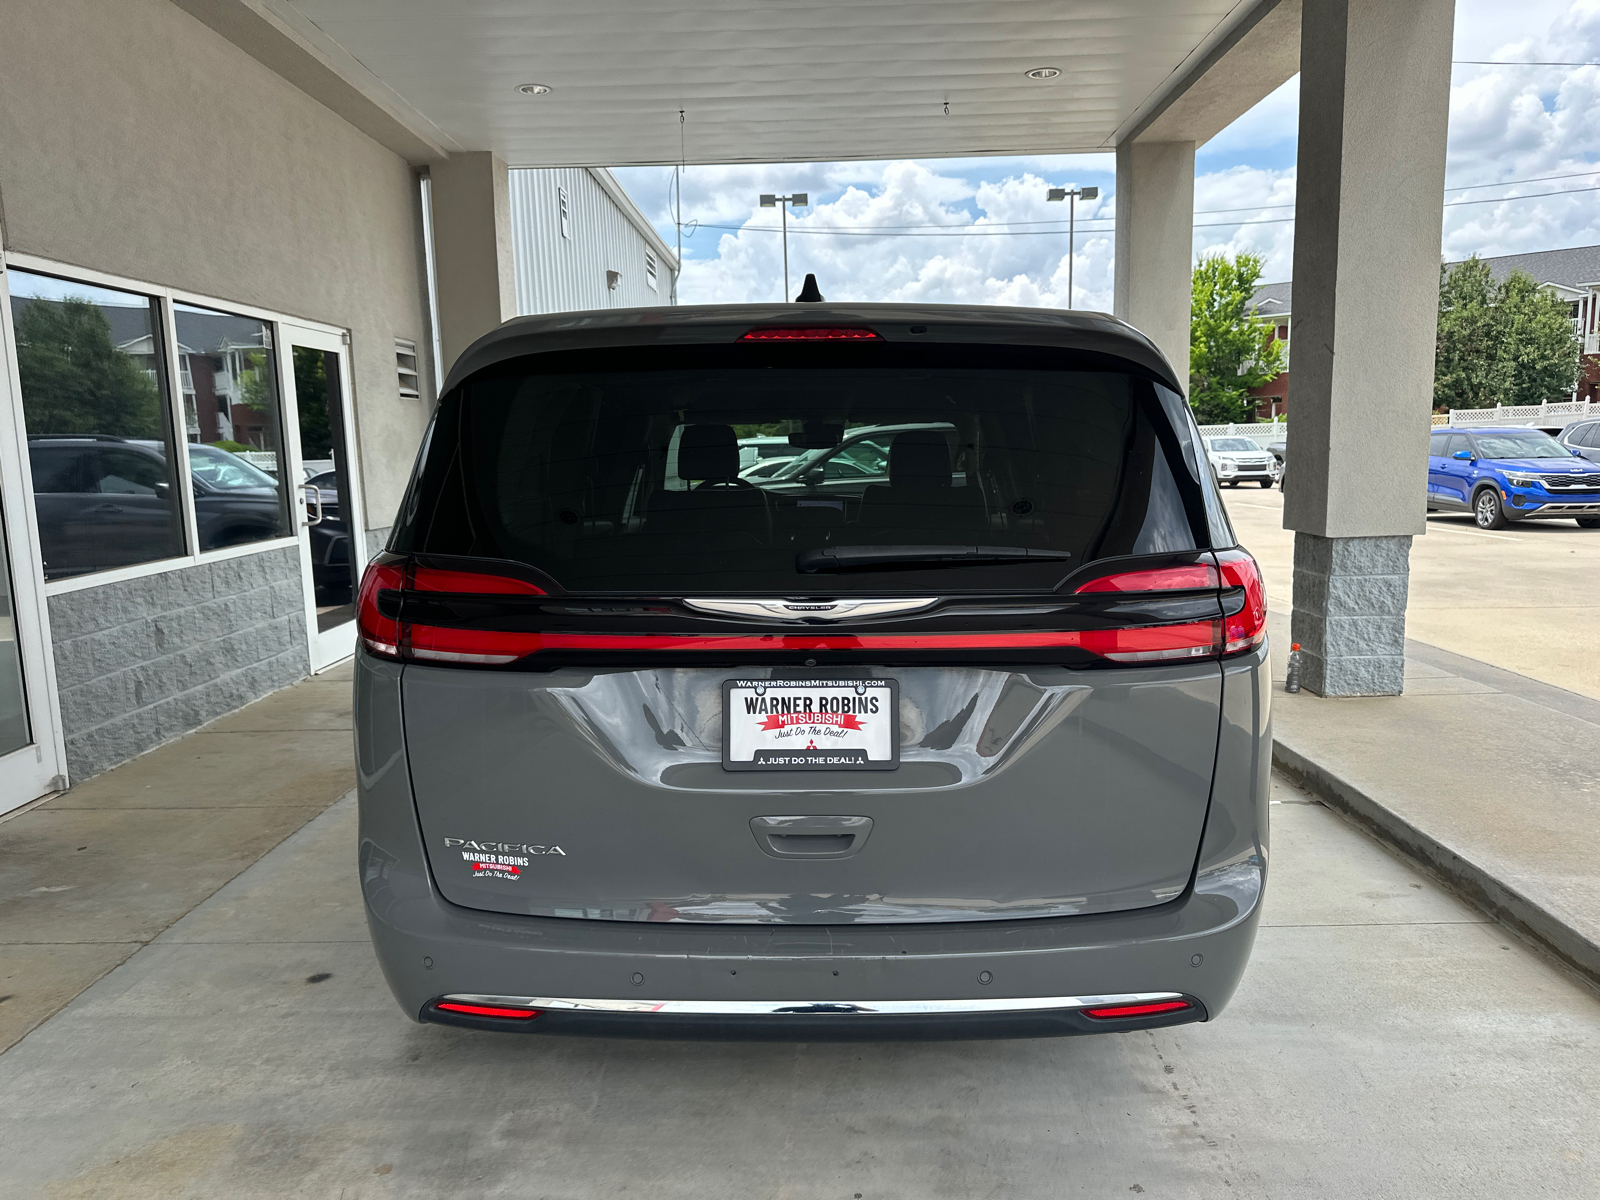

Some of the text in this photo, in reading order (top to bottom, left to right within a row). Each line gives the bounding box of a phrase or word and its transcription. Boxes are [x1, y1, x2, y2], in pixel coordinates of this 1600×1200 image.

[744, 696, 879, 714] WARNER ROBINS
[778, 714, 844, 725] MITSUBISHI
[775, 726, 848, 739] Just Do The Deal!
[444, 837, 566, 856] PACIFICA
[462, 851, 529, 866] WARNER ROBINS
[479, 863, 512, 871] MITSUBISHI
[504, 872, 520, 881] Deal!
